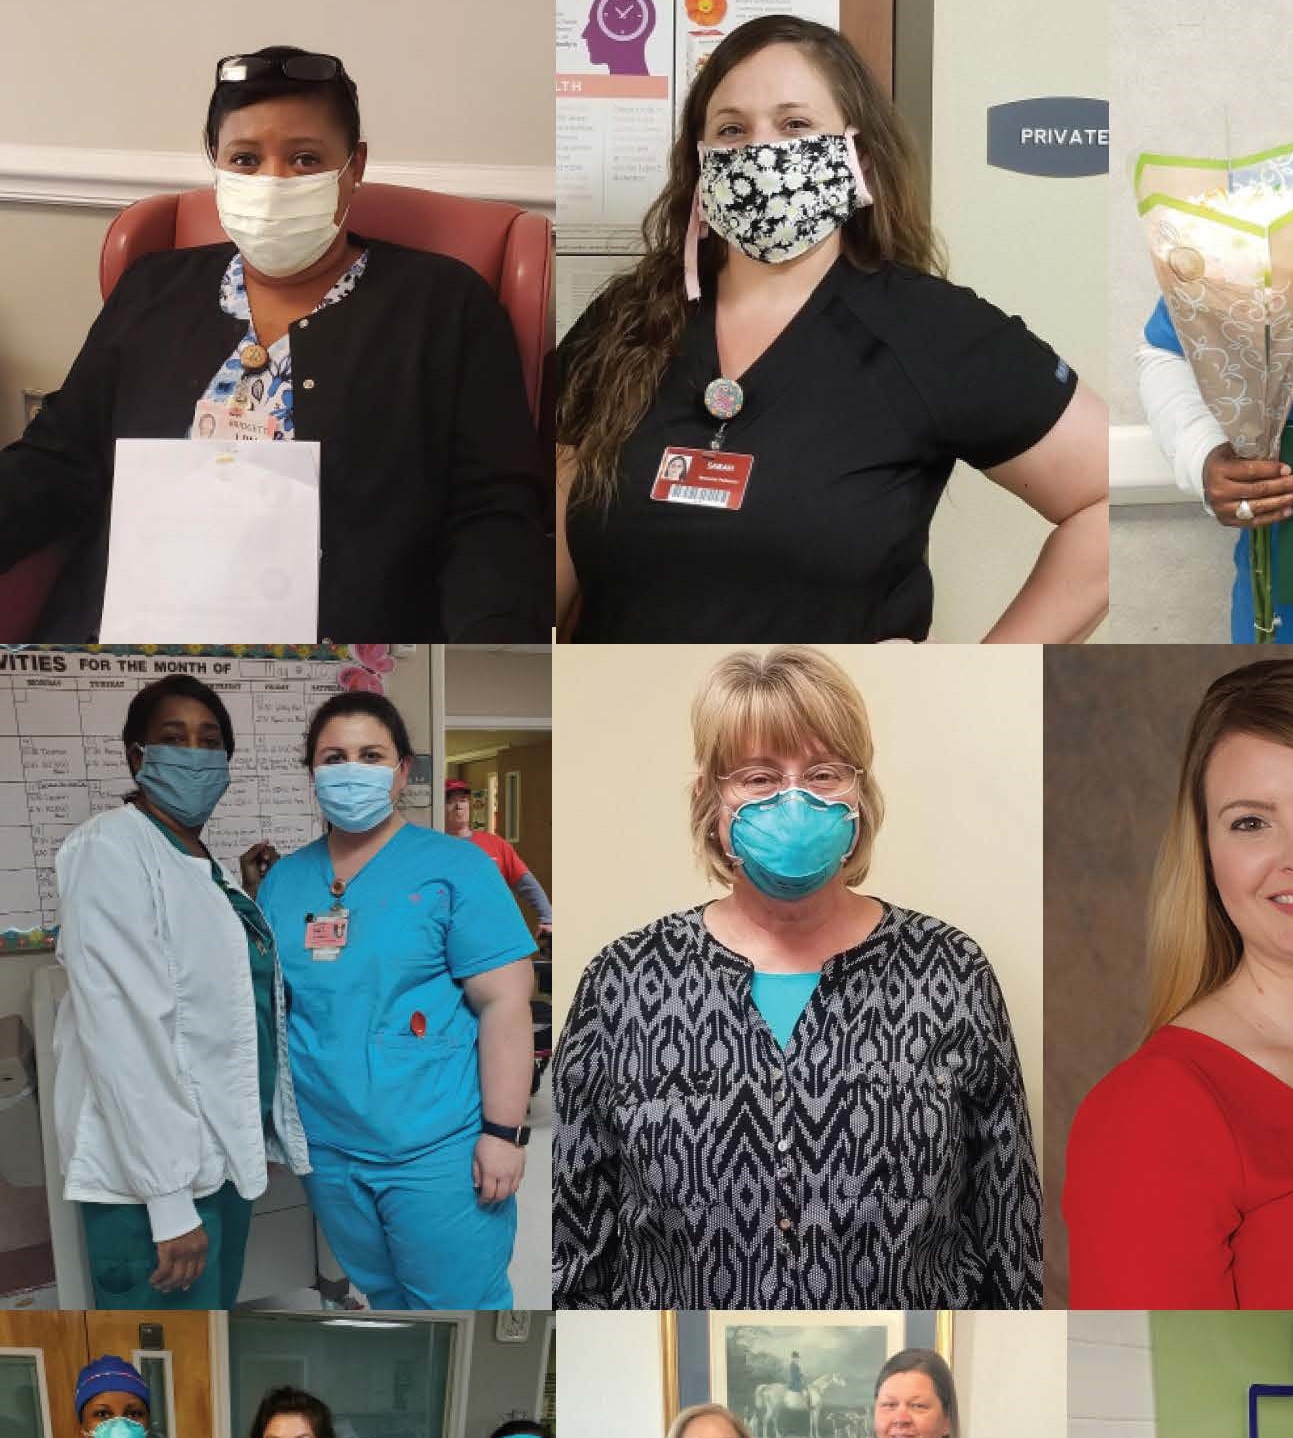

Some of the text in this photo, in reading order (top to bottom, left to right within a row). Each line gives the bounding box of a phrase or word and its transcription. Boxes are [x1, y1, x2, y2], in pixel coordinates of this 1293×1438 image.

[1020, 127, 1109, 146] PRIVATE
[79, 657, 112, 671] FOR
[116, 659, 148, 673] THE
[154, 661, 207, 674] MONTH
[213, 662, 232, 675] OF
